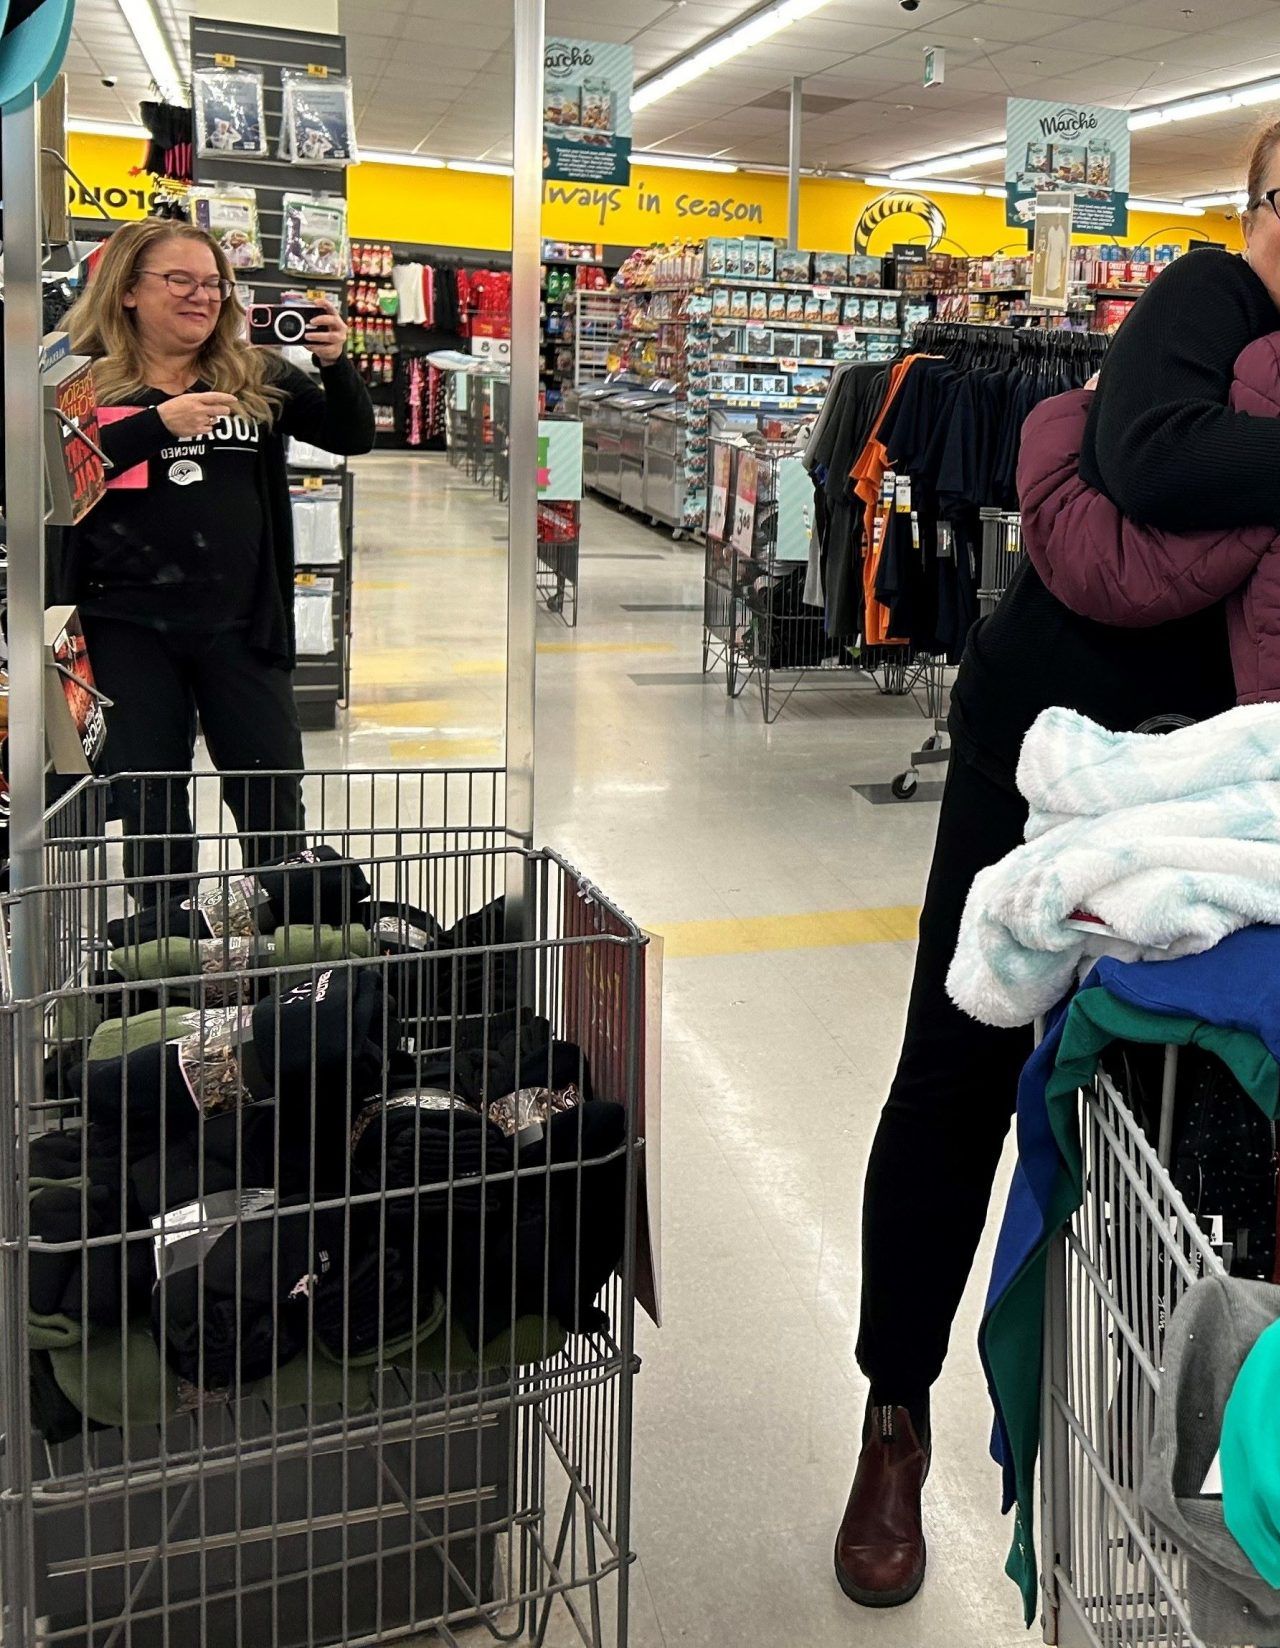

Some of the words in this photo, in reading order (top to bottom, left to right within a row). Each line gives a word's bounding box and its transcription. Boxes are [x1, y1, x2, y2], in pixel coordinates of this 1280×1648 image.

[543, 46, 594, 73] arché
[1039, 111, 1098, 137] Marché
[543, 180, 622, 226] lways
[637, 182, 661, 214] in
[675, 193, 763, 224] season
